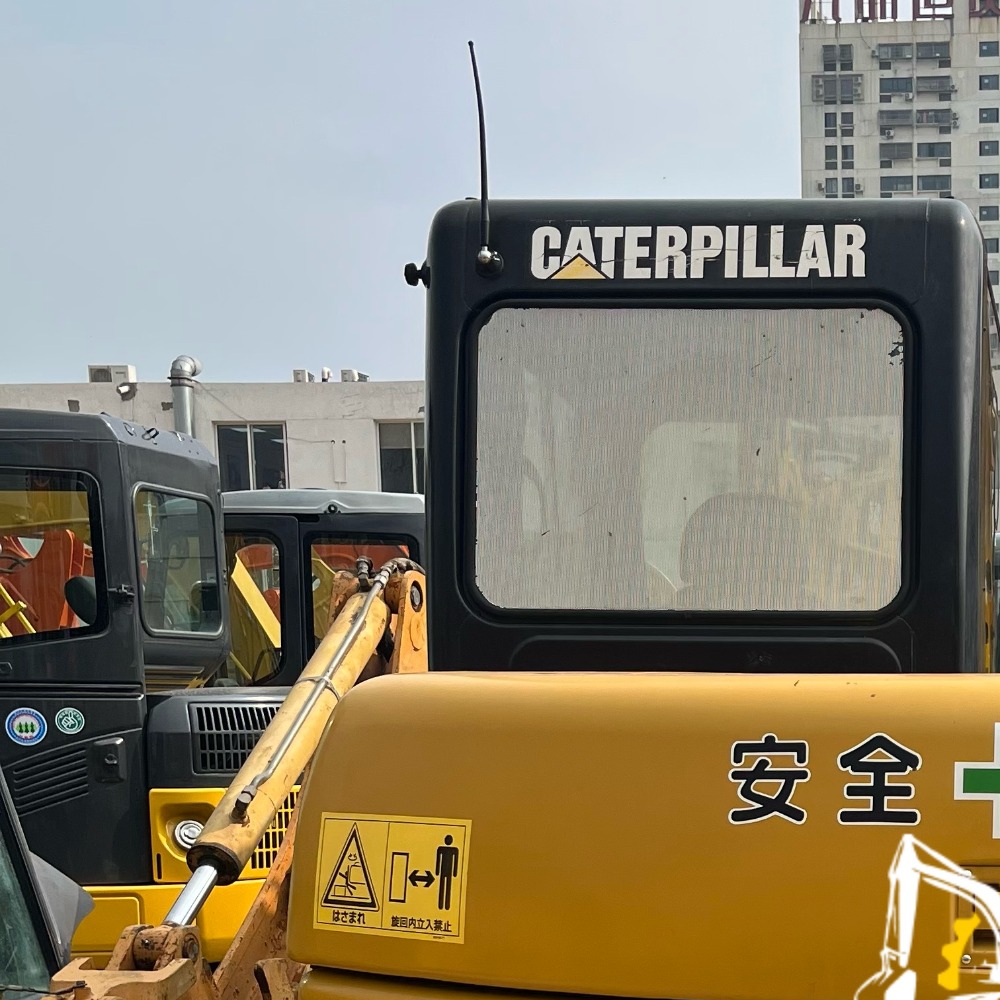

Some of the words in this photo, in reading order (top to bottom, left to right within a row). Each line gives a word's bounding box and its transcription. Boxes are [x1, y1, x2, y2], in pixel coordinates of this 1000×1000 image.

[530, 224, 866, 280] CATERPILLAR
[728, 733, 922, 826] 安全
[332, 910, 366, 924] はさまれ
[391, 916, 452, 932] 旋回内立入禁止
